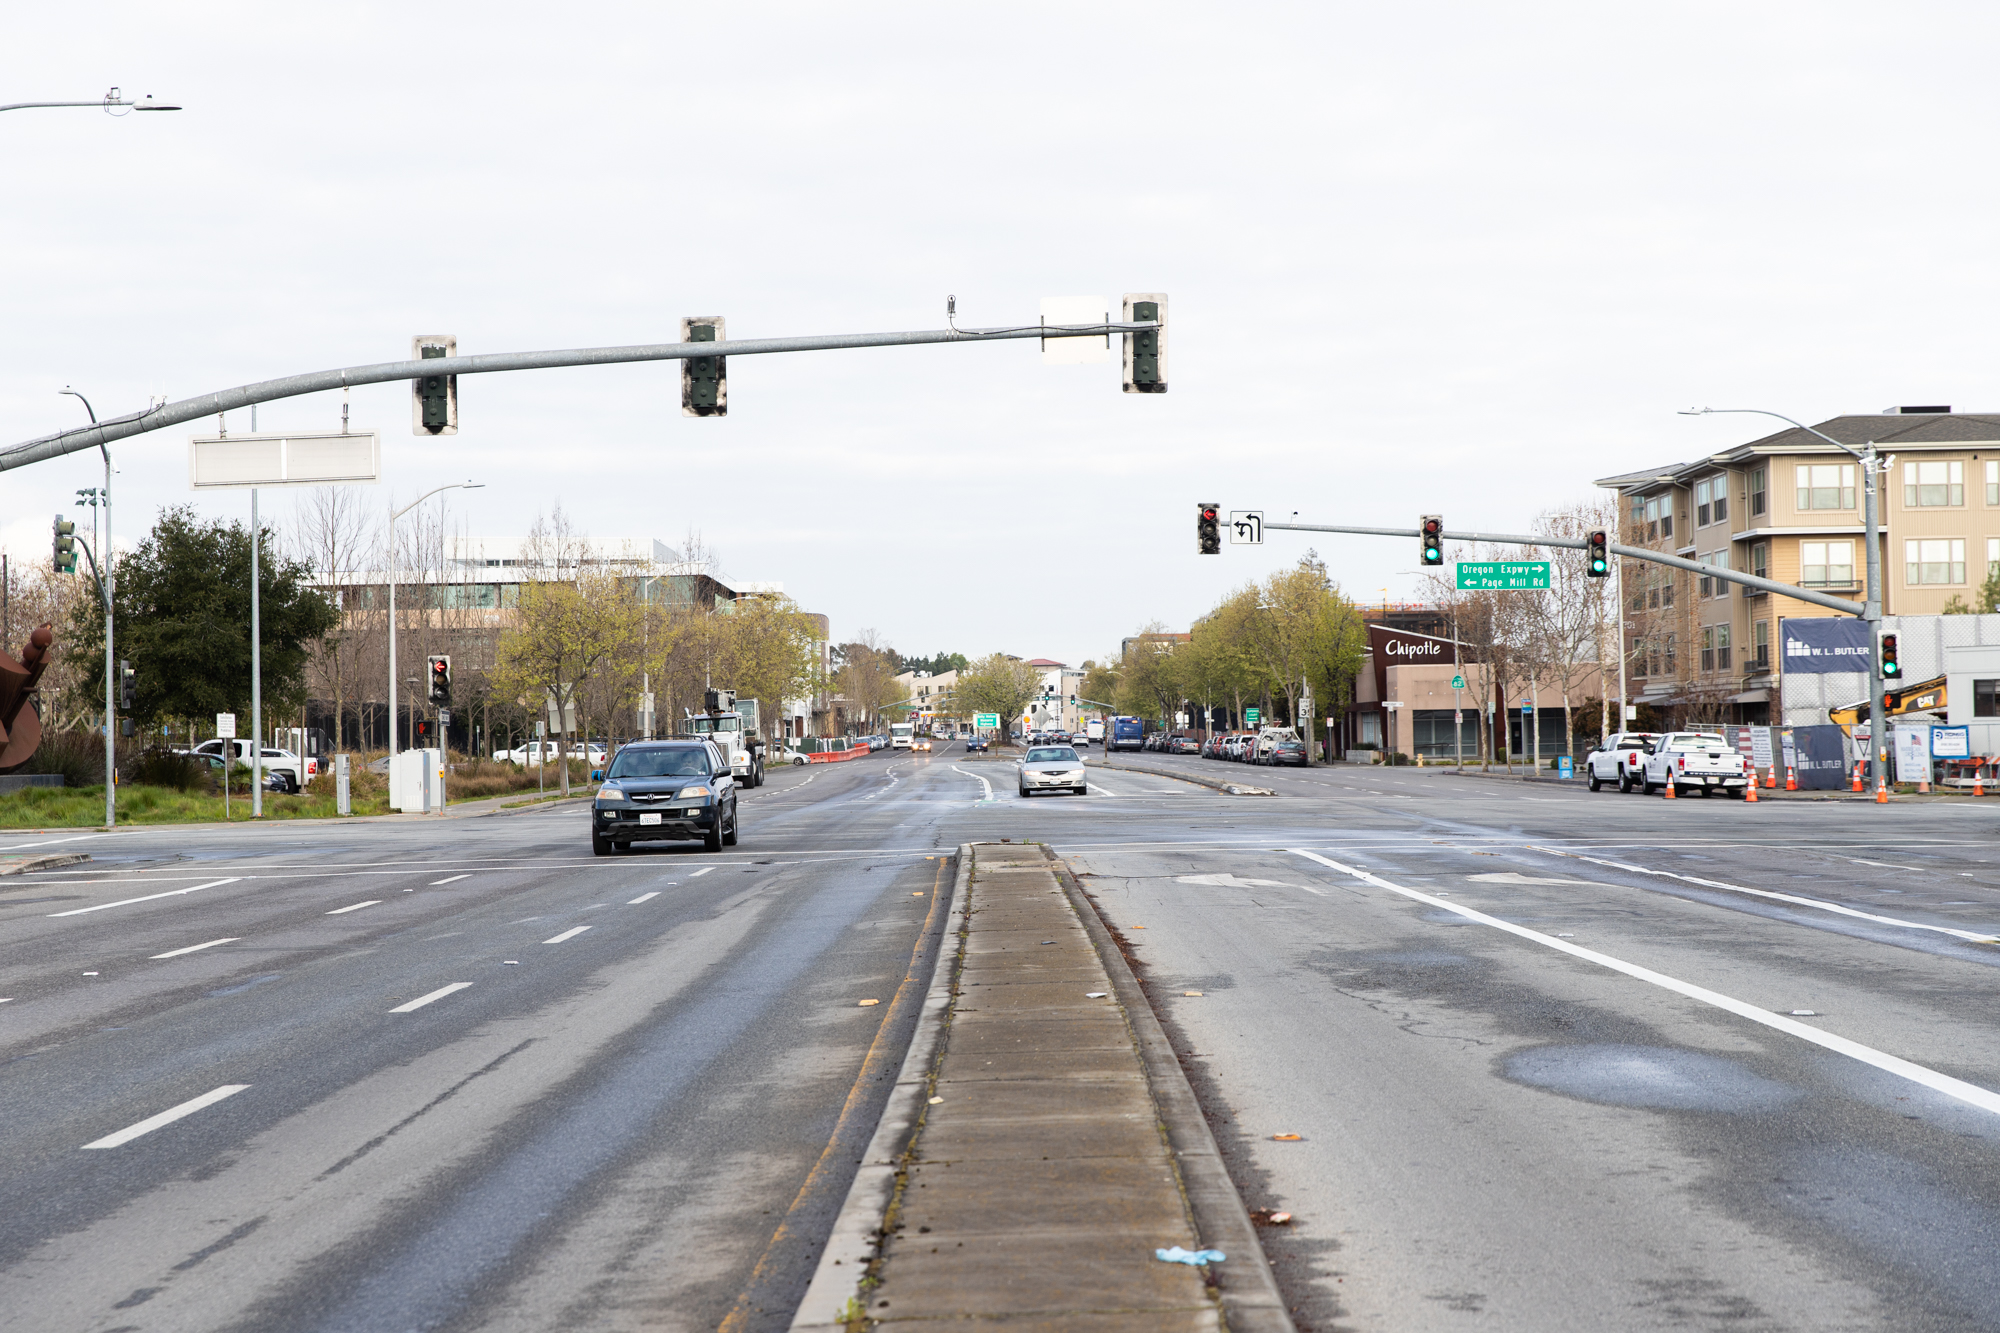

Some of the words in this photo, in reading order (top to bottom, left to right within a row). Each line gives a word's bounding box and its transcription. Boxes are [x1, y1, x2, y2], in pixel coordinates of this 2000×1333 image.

[1462, 564, 1494, 576] Oregon
[1501, 564, 1530, 576] Expwy
[1482, 578, 1503, 589] Page
[1509, 578, 1526, 587] Mill
[1533, 577, 1544, 587] Rd
[1385, 639, 1441, 659] Chipotle
[1811, 648, 1823, 656] W.
[1824, 648, 1834, 656] L.
[1834, 647, 1870, 656] BUTLER
[1916, 695, 1935, 708] CAT
